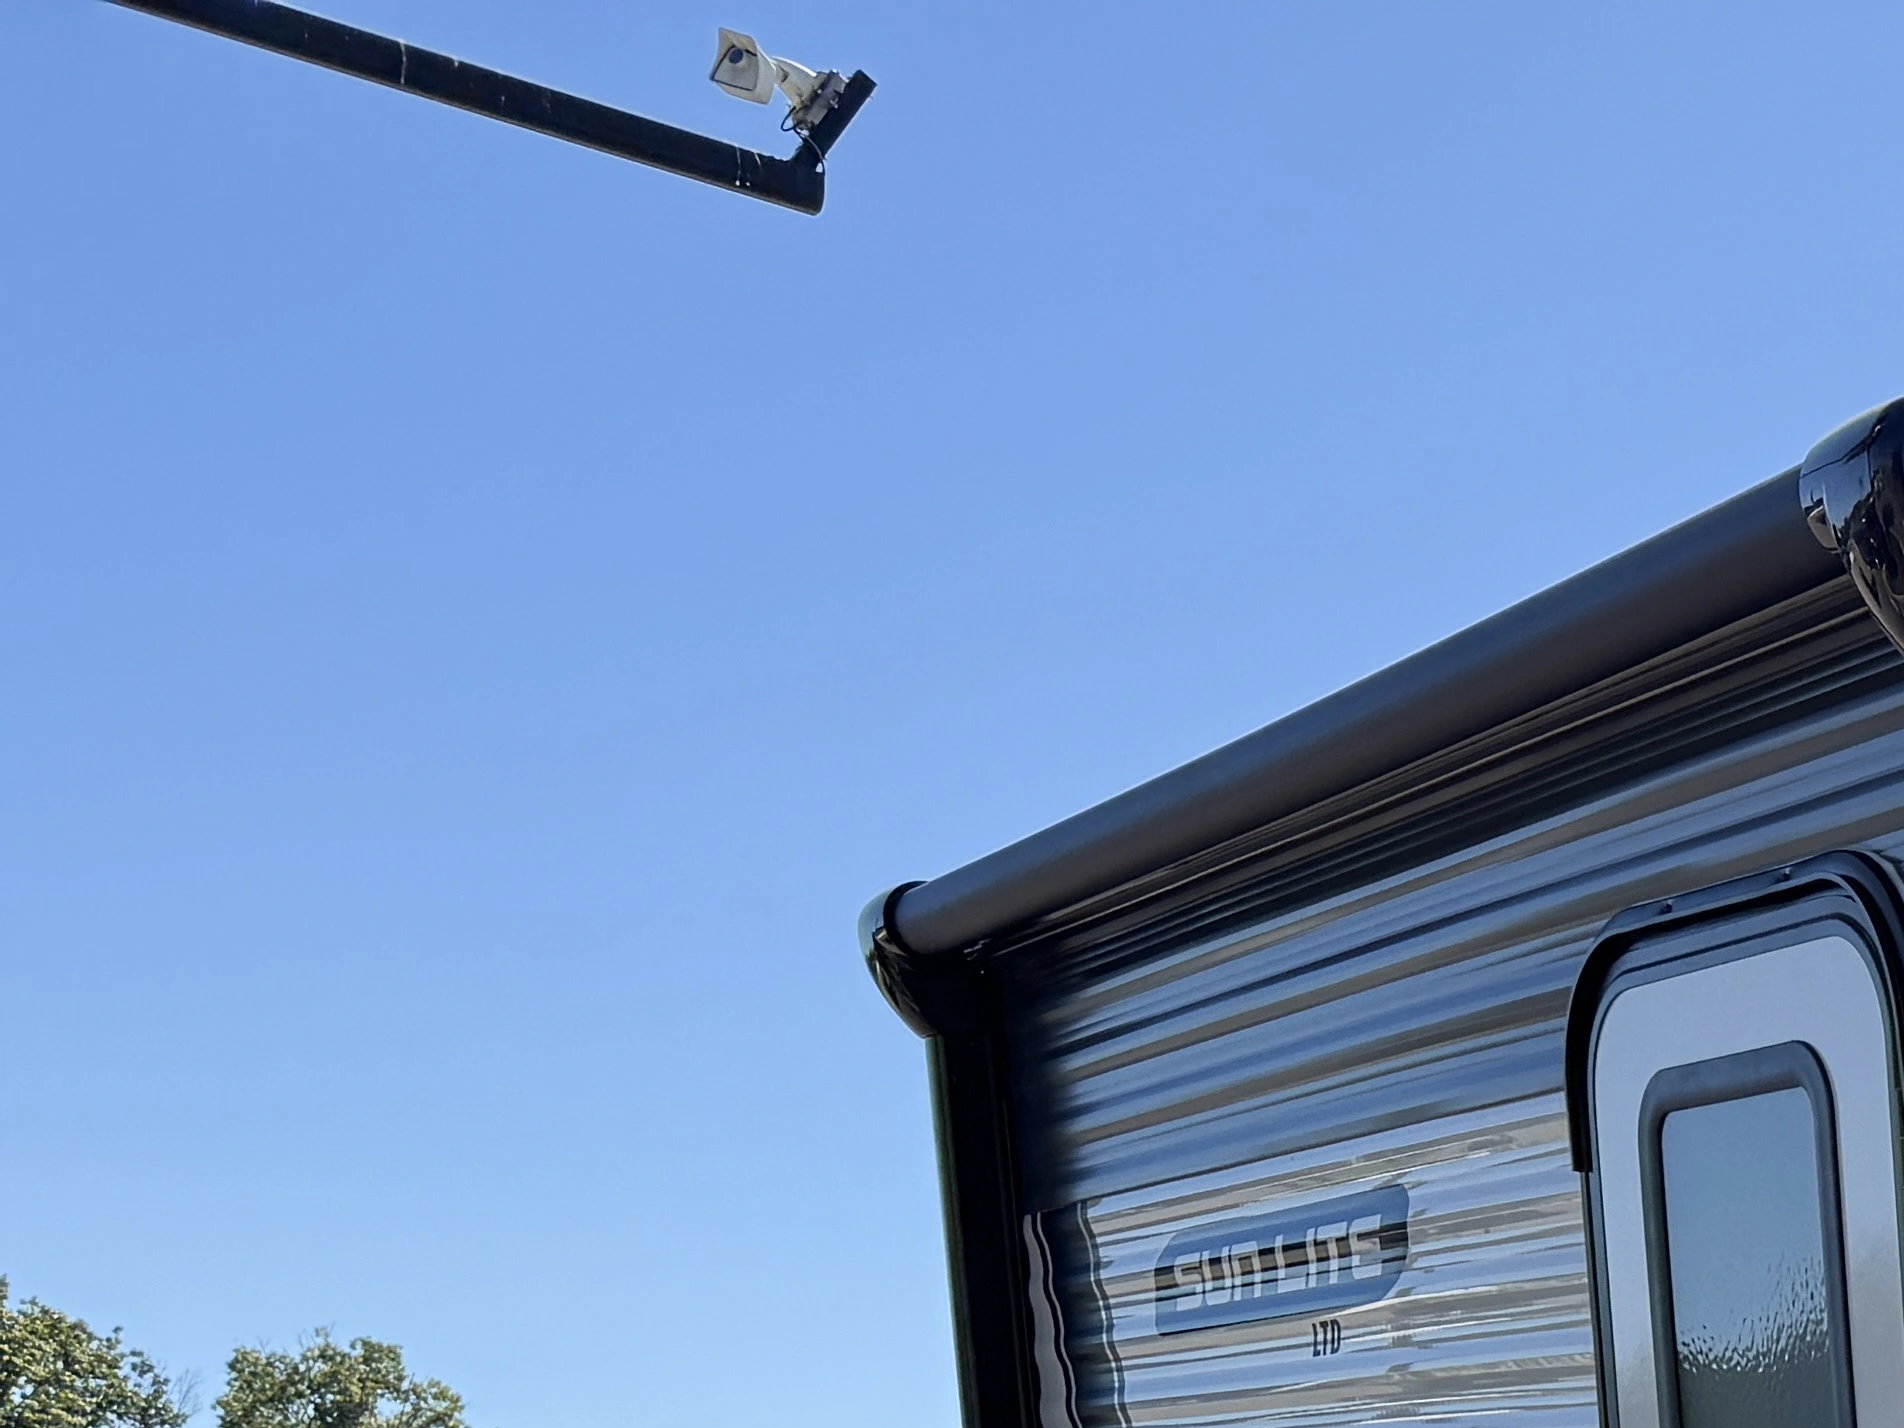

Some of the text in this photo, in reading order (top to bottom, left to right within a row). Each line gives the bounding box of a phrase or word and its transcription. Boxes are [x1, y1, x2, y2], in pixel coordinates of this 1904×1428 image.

[1173, 1213, 1383, 1312] SUN LITE
[1311, 1318, 1342, 1358] LTD
